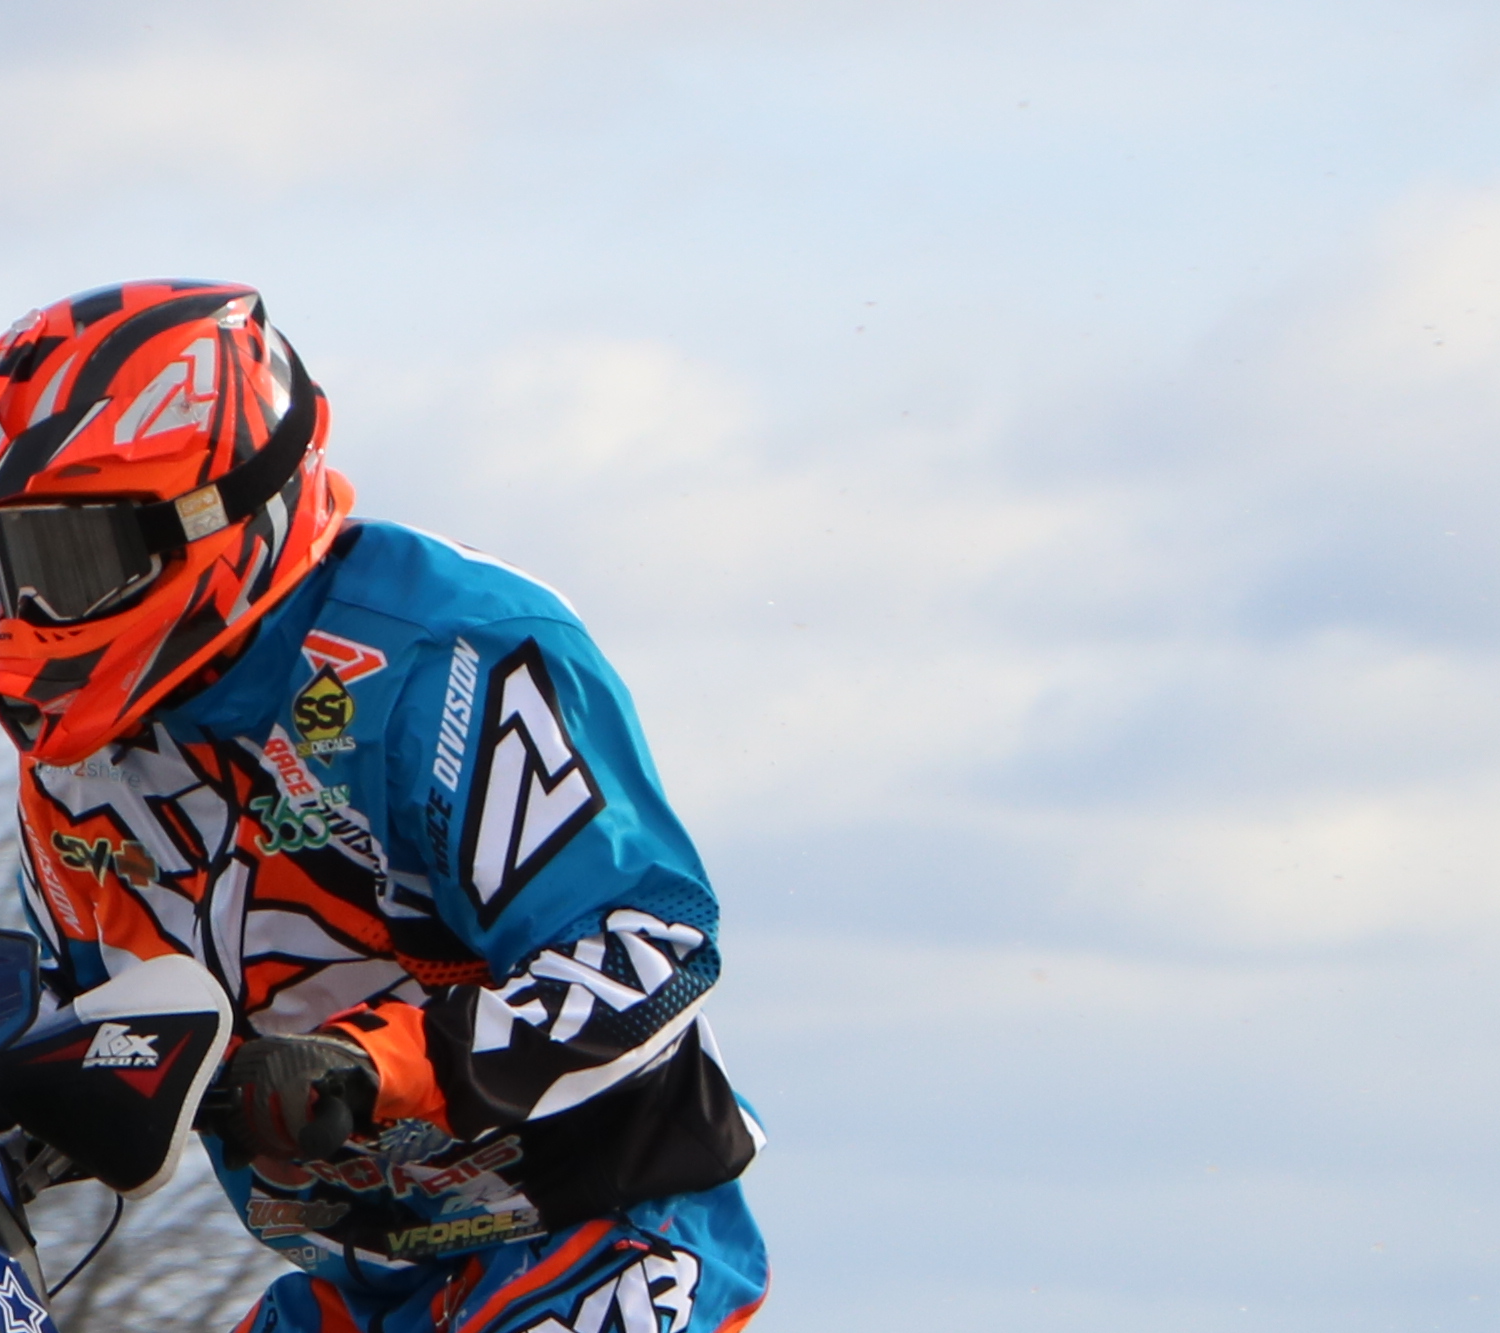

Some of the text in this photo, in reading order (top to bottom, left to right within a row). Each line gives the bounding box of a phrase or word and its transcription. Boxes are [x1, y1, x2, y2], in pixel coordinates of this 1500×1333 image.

[433, 636, 480, 793] DIVISION
[264, 737, 315, 798] RACE
[249, 795, 332, 857] 360
[470, 907, 705, 1055] FXR
[133, 1056, 159, 1068] FX
[386, 1206, 541, 1252] VFORCE3
